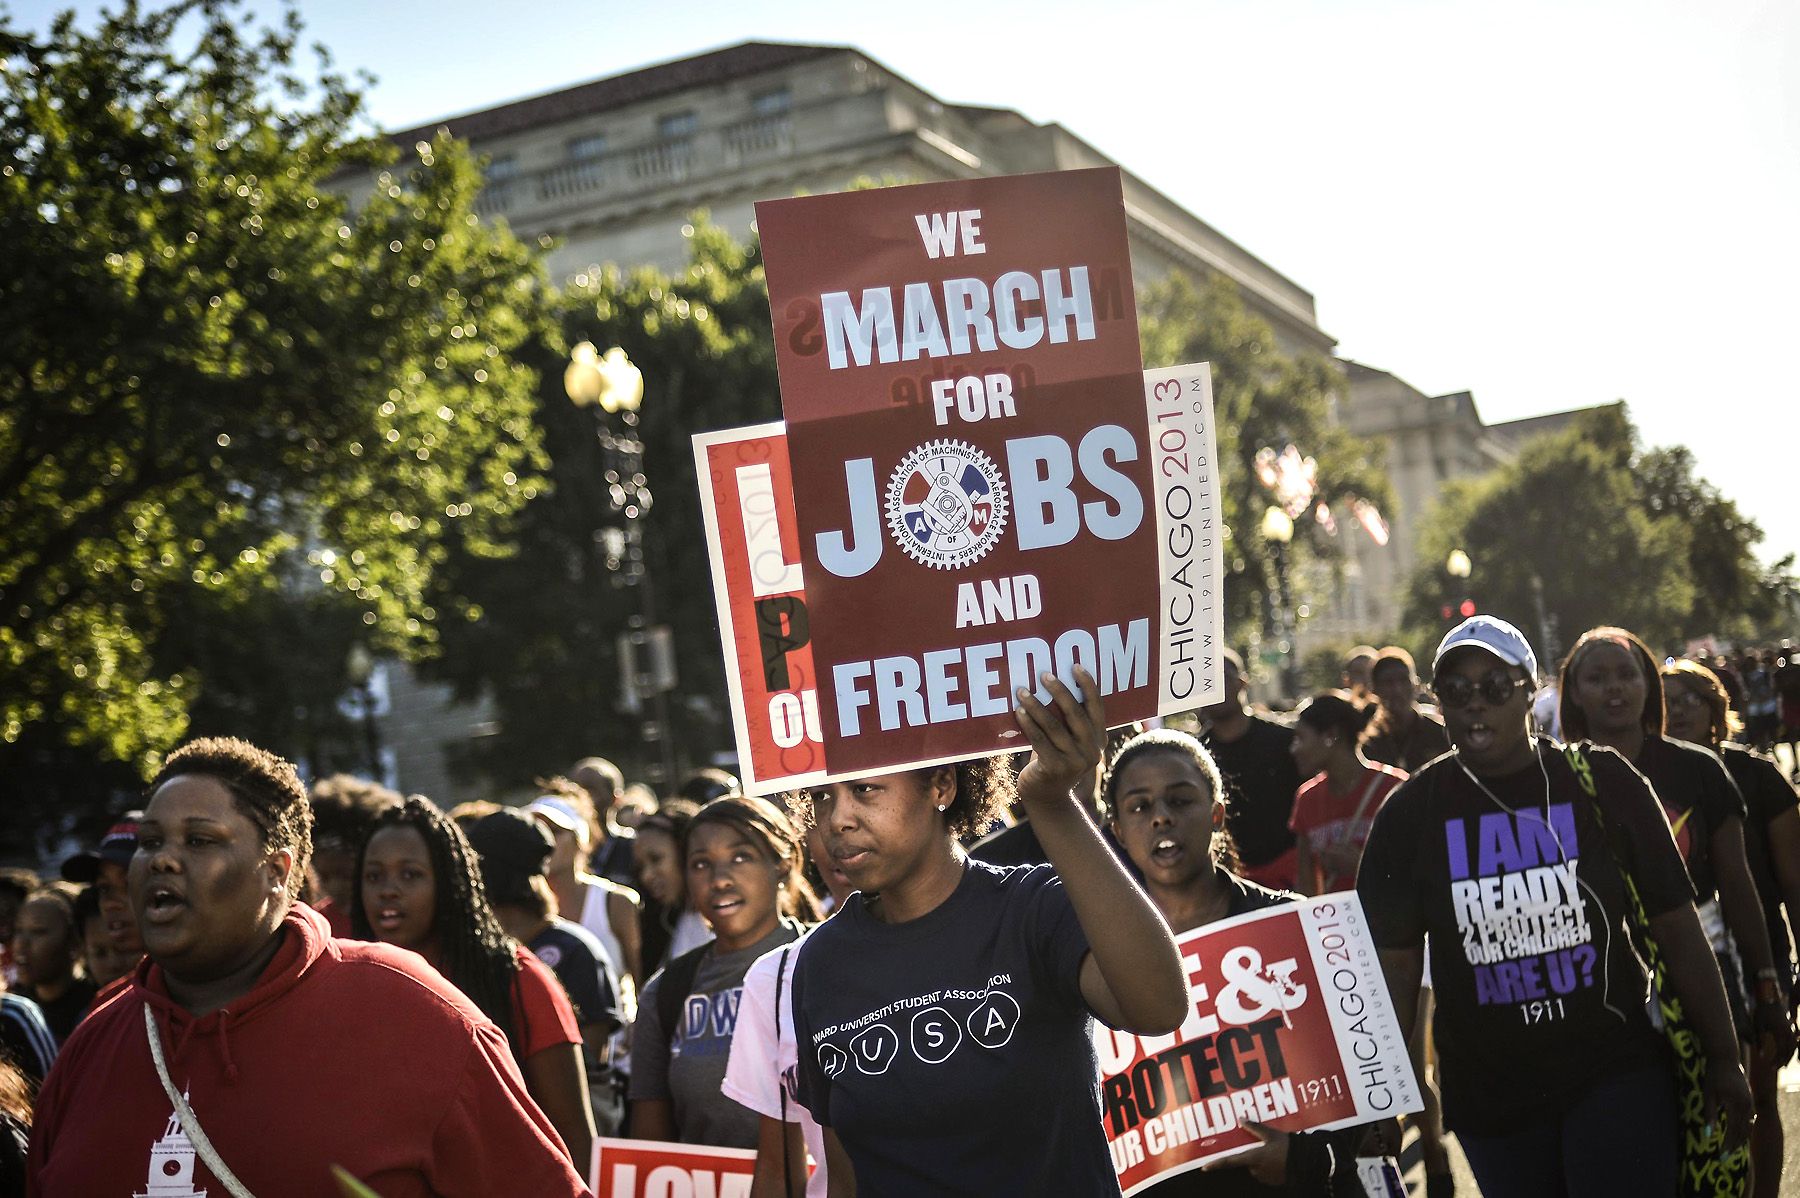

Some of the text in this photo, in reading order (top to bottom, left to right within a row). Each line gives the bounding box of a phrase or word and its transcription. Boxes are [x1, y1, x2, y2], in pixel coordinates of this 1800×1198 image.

[914, 209, 986, 259] WE
[820, 265, 1096, 370] MARCH
[930, 373, 1017, 426] FOR
[893, 446, 1002, 561] INTERNATIONAL ASSOCIATION OF MACHINISTS AND AEROSPACE WORKERS
[913, 517, 927, 534] A
[973, 508, 988, 525] M
[947, 536, 957, 544] OF
[1153, 378, 1195, 700] CHICAGO 2013
[955, 573, 1042, 629] AND
[832, 617, 1150, 738] FREEDOM
[1445, 817, 1470, 881] I
[1478, 801, 1579, 877] AM
[1451, 858, 1579, 927] READY
[1312, 903, 1350, 966] 2013
[1464, 922, 1592, 966] OUR CHILDREN
[1475, 899, 1586, 949] PROTECT
[1473, 944, 1598, 1006] ARE U?
[840, 1004, 893, 1032] UNIVERSITY
[893, 991, 942, 1012] STUDENT
[1332, 969, 1393, 1111] CHICAGO
[1520, 997, 1566, 1026] 1911
[1100, 1016, 1288, 1136] ROTECT
[1297, 1074, 1342, 1104] 1911
[1143, 1076, 1299, 1156] CHILDREN
